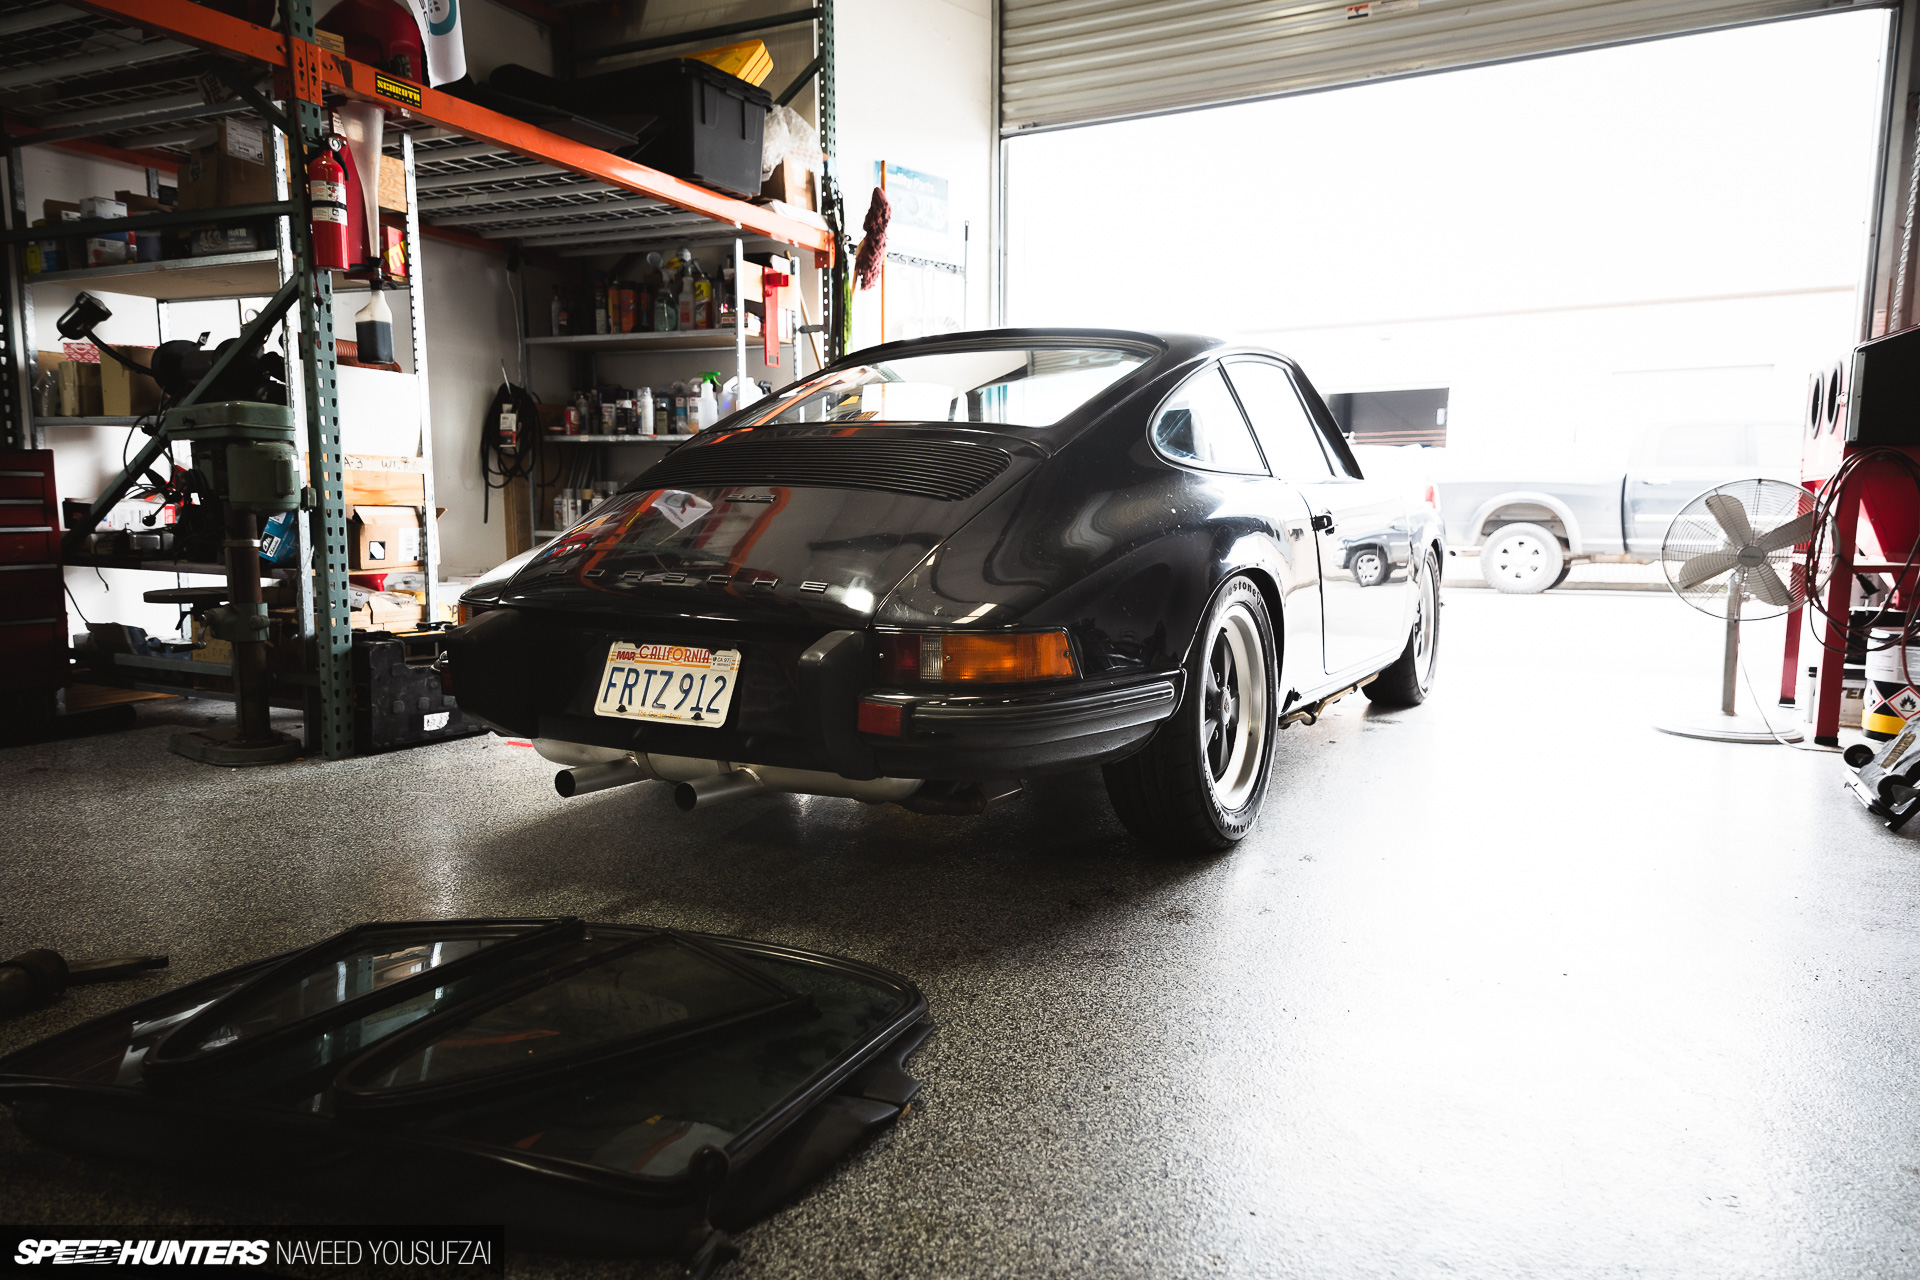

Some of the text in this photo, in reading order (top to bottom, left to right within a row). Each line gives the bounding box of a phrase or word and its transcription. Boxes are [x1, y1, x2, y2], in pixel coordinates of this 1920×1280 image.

[376, 79, 420, 102] SCHROTH
[546, 568, 829, 594] PORSCHE
[616, 651, 636, 661] MAR
[640, 645, 711, 664] CALIFORNIA
[602, 666, 727, 714] FRTZ912
